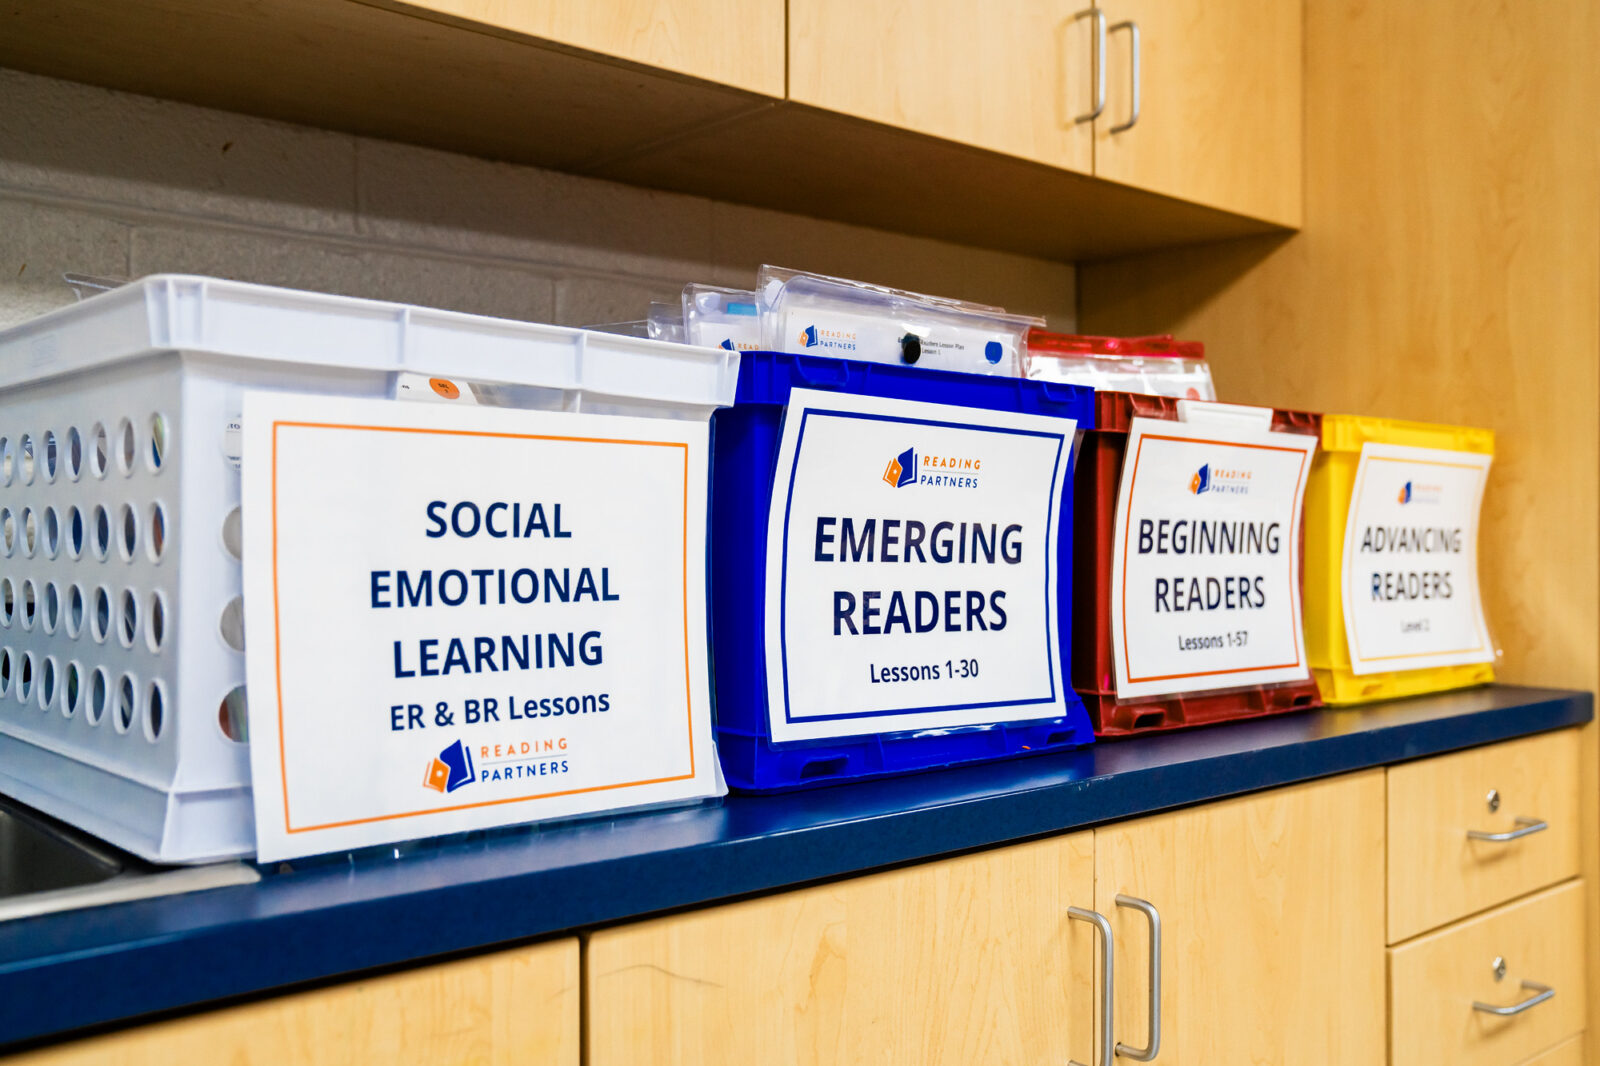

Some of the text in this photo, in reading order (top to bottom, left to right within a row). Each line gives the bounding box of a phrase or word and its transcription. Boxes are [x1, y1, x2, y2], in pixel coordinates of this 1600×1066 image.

[820, 340, 856, 351] PARTNERS
[924, 455, 981, 470] READING
[920, 475, 979, 489] PARTNERS
[425, 501, 572, 539] SOCIAL
[814, 516, 1023, 565] EMERGING
[1138, 518, 1280, 555] BEGINNING
[1361, 526, 1462, 554] ADVANCING
[370, 567, 620, 609] EMOTIONAL
[1155, 576, 1265, 613] READERS
[1371, 571, 1453, 601] READERS
[833, 589, 1008, 636] READERS
[393, 630, 603, 678] LEARNING
[1178, 631, 1249, 652] Lessons 1-57
[870, 658, 979, 684] Lessons 1-30
[390, 693, 610, 732] ER & BR Lessons
[480, 738, 568, 758] READING
[481, 760, 569, 783] PARTNERS
